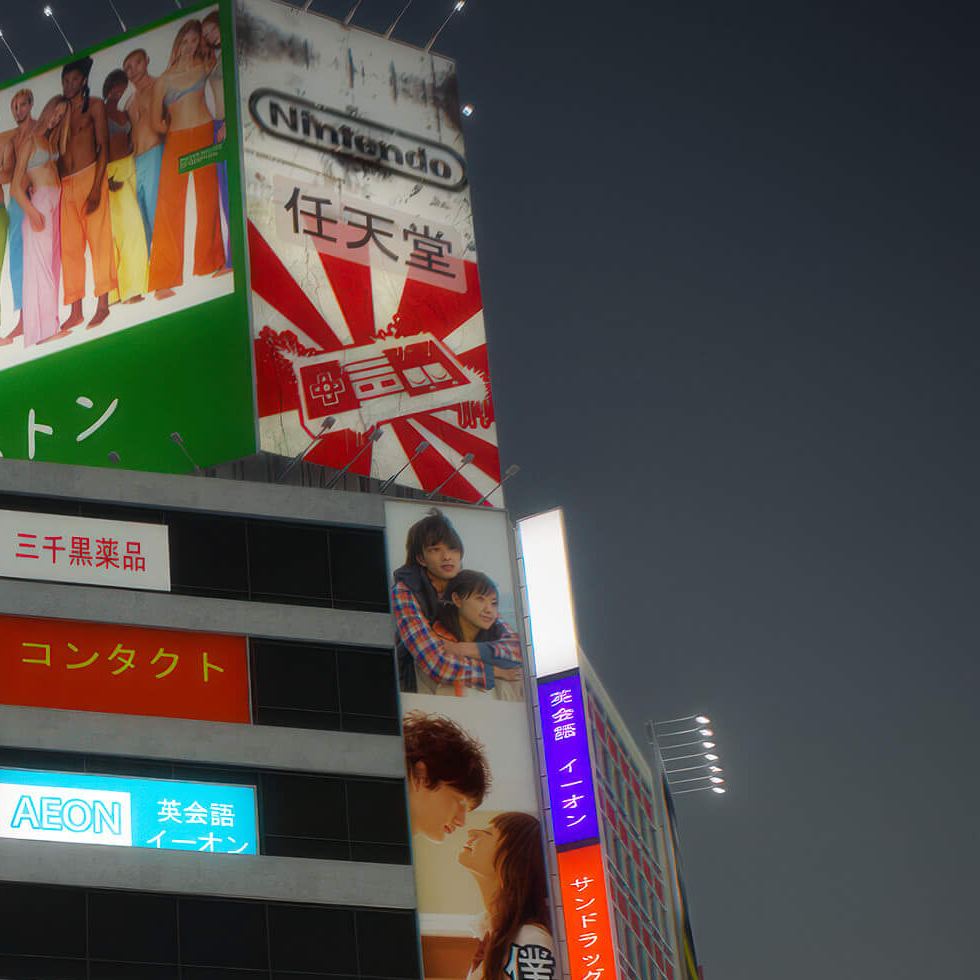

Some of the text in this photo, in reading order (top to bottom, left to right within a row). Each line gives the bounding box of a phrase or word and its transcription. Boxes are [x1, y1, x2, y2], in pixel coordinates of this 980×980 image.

[269, 102, 452, 180] Nintendo
[284, 186, 456, 279] 任天堂
[21, 642, 224, 683] コンタクト
[12, 795, 121, 835] AEON
[157, 798, 235, 828] 英会話
[146, 829, 248, 854] イーオン
